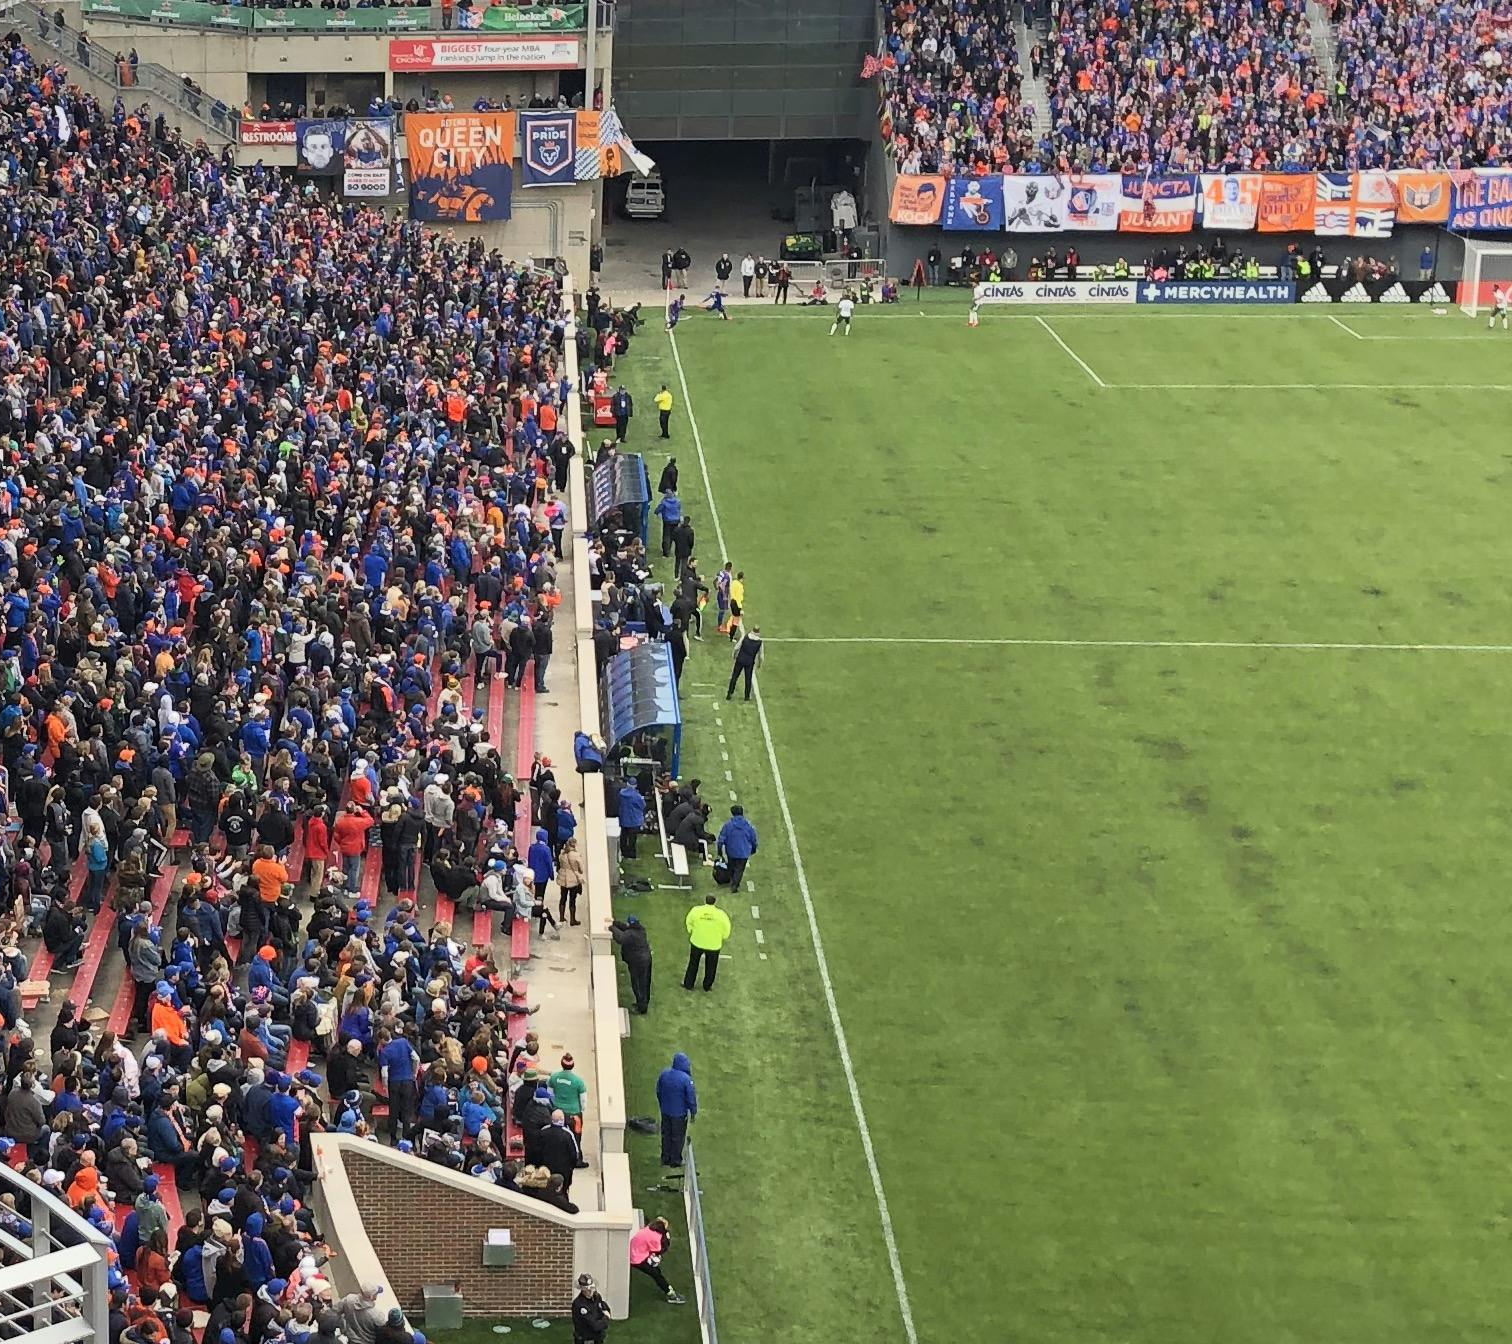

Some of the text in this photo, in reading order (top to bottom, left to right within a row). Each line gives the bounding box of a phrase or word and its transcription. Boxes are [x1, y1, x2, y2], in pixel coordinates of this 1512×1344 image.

[504, 12, 548, 22] Heineken
[440, 44, 482, 53] BIGGEST
[440, 54, 474, 62] rankings
[475, 54, 497, 62] jump
[242, 131, 297, 143] RESTROOMS
[419, 126, 502, 148] QUEEN
[532, 130, 567, 140] PRIDE
[433, 146, 488, 169] CITY
[347, 183, 386, 191] SO GOOD
[1124, 180, 1191, 196] JUNCTA
[1455, 177, 1486, 209] THE
[897, 211, 934, 224] KOCH
[1123, 212, 1189, 228] JUVANT
[1452, 211, 1476, 229] AS
[1164, 286, 1289, 299] MERCYHEALTH
